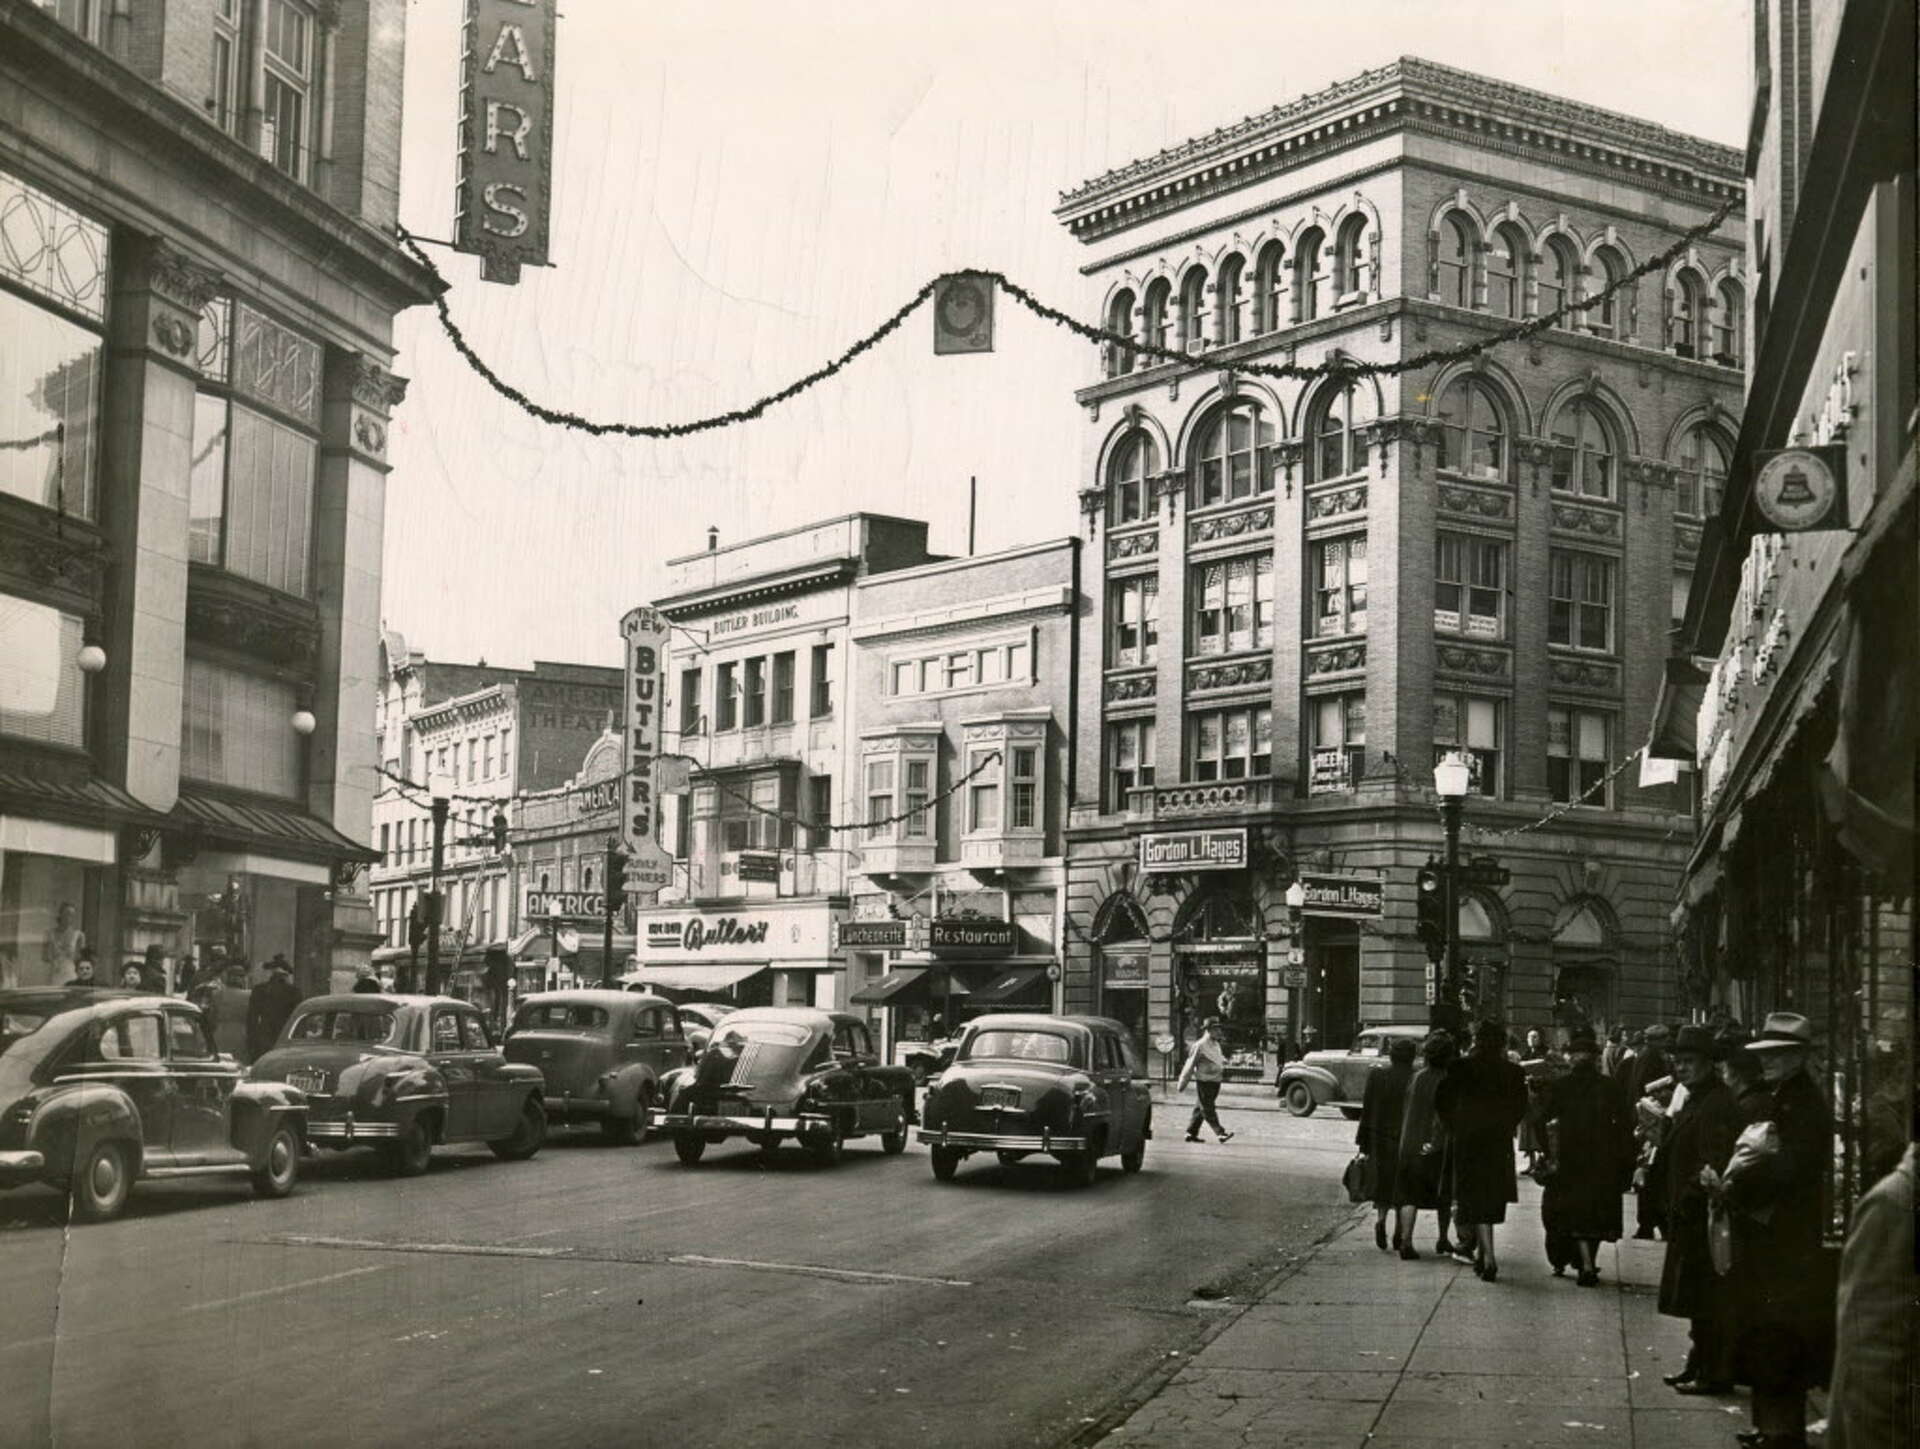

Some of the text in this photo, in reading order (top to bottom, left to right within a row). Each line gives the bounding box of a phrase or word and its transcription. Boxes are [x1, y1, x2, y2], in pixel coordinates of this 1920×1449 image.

[482, 0, 537, 237] ARS
[627, 620, 665, 636] NEW
[714, 605, 799, 634] BUTLER BUILDING
[632, 646, 656, 837] BUTLER'S
[1146, 833, 1240, 863] Gordon L Hayes
[1303, 883, 1340, 902] Gordon
[1349, 886, 1381, 908] Hayes
[683, 917, 769, 951] Butler's
[841, 926, 902, 944] Luncheonette
[934, 927, 1011, 944] Restaurant
